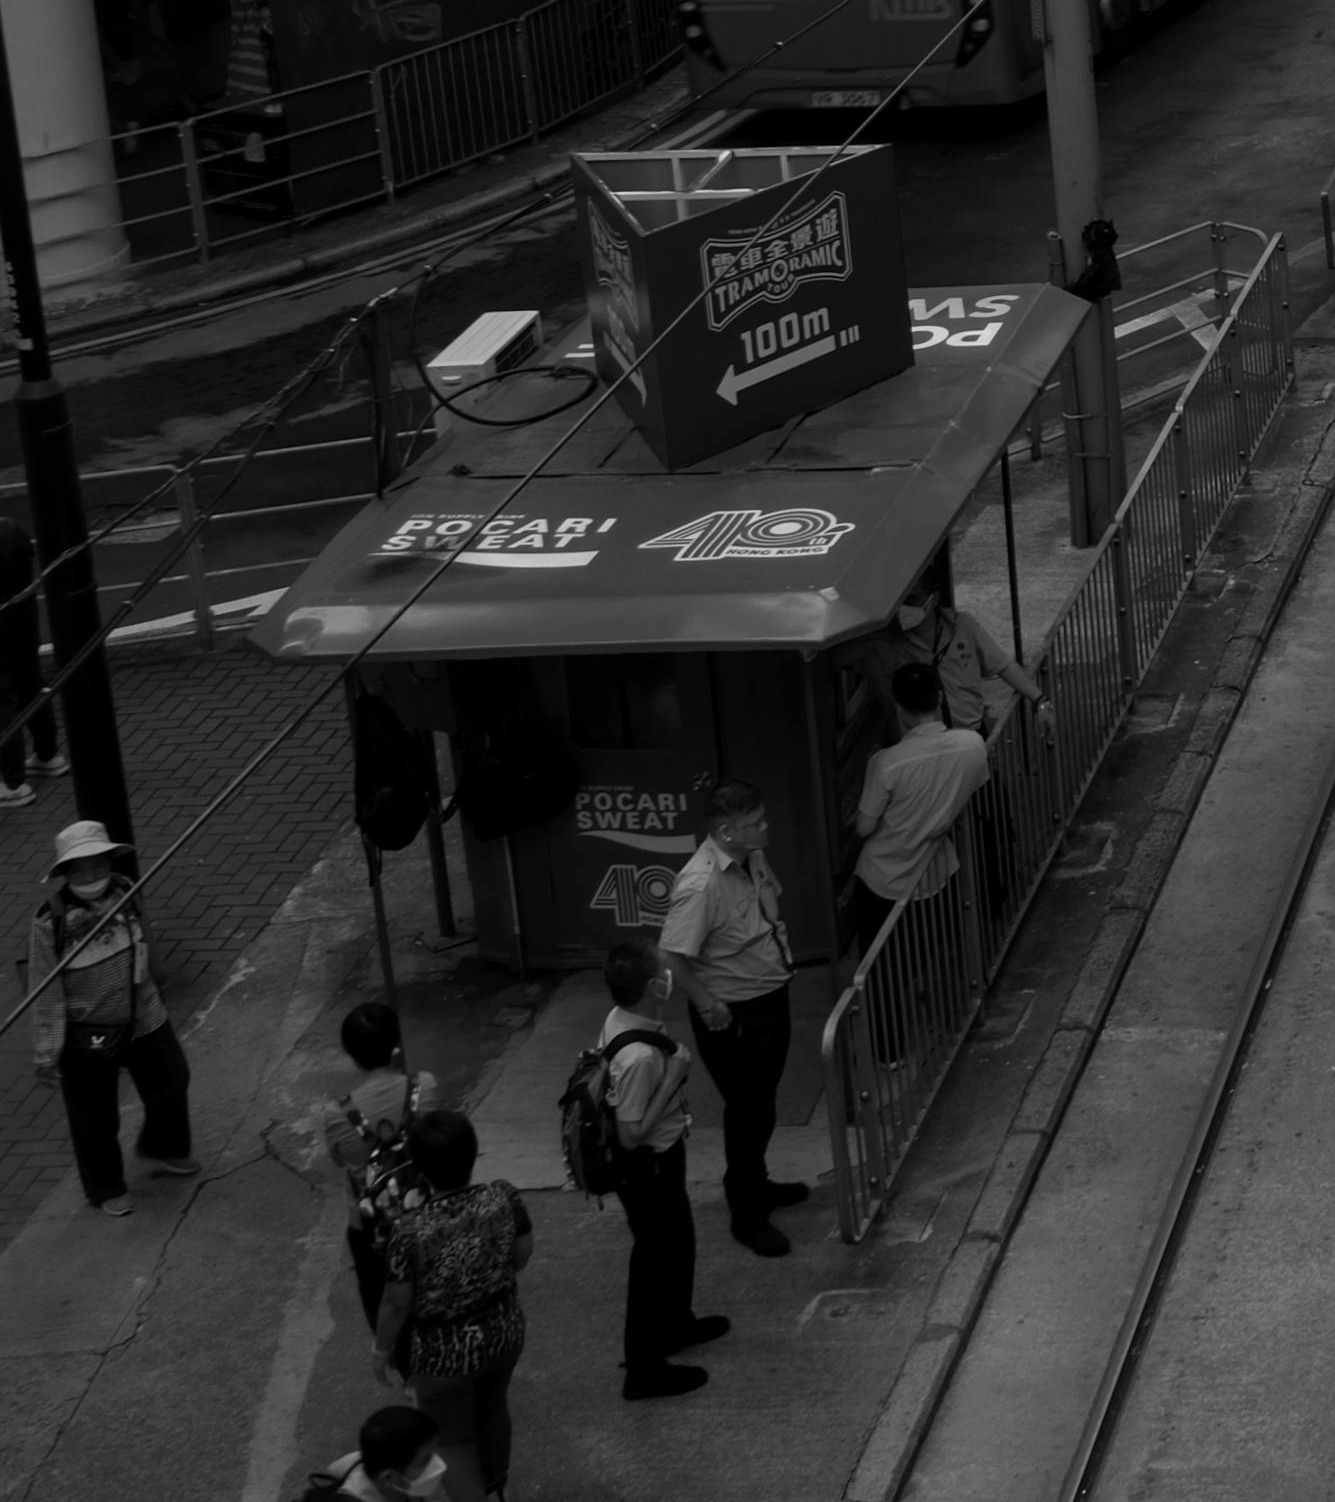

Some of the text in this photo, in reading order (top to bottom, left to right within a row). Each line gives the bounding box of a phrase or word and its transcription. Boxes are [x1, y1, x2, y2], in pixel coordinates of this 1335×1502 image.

[711, 208, 838, 279] 電車全景遊
[715, 239, 844, 315] TRAMORAMIC
[741, 306, 831, 364] 100m
[395, 517, 618, 535] POCARI
[381, 533, 586, 551] SWEAT
[726, 546, 824, 556] HONG KONG
[575, 792, 688, 811] POCARI
[577, 810, 678, 830] SWEAT
